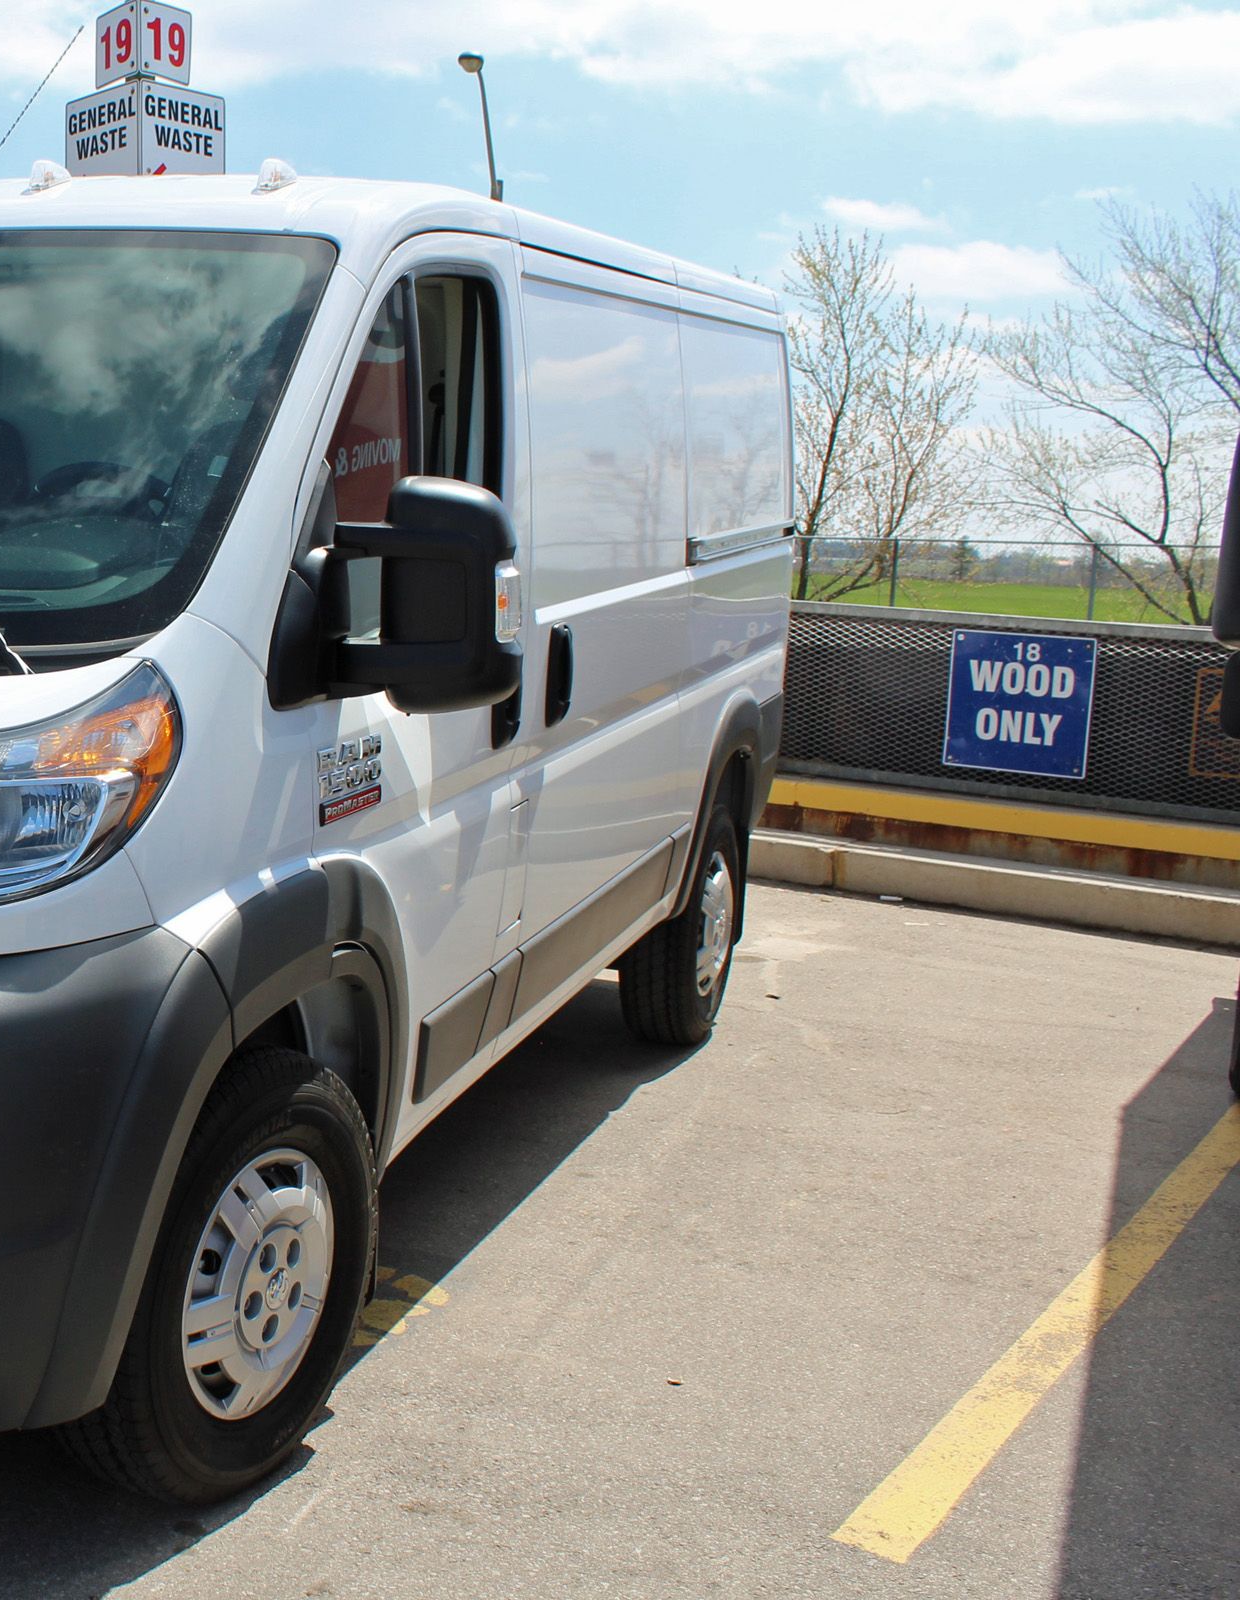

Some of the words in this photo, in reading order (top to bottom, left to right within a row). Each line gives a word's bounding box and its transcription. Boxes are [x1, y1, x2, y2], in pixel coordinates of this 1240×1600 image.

[101, 18, 132, 70] 19
[147, 17, 185, 67] 19
[68, 96, 136, 136] GENERAL
[145, 94, 223, 132] GENERAL
[76, 125, 127, 161] WASTE
[154, 124, 213, 157] WASTE
[1013, 642, 1041, 662] 18
[969, 659, 1075, 699] WOOD
[975, 707, 1062, 747] ONLY
[317, 733, 381, 773] RAM
